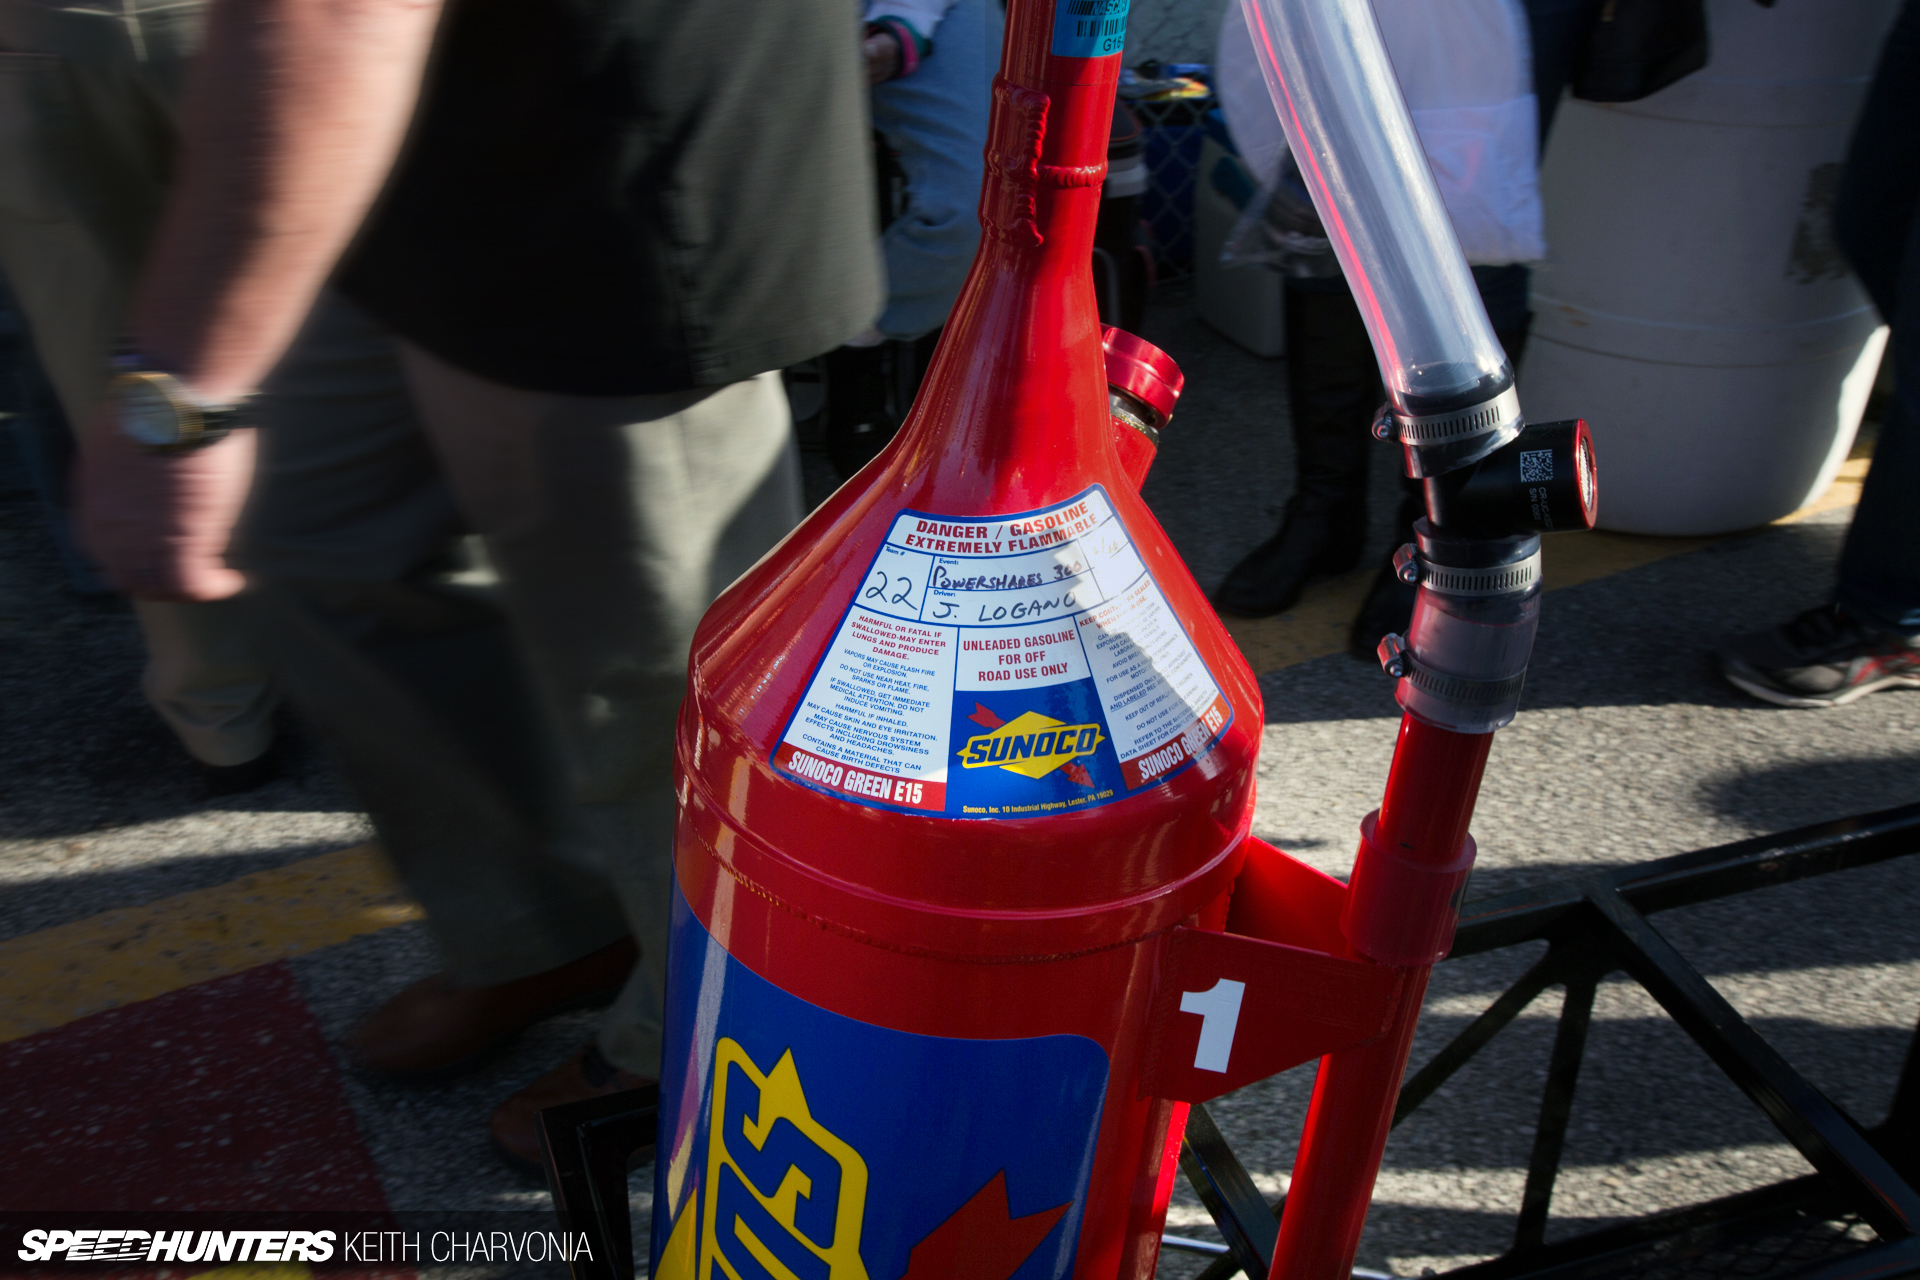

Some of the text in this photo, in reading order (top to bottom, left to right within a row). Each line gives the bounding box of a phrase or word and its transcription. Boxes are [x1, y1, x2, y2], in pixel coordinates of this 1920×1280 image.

[1529, 487, 1538, 502] S/N
[916, 501, 1089, 539] DANGER / GASOLINE
[905, 534, 1002, 553] EXTREMELY
[1008, 513, 1098, 552] FLAMMABLE
[885, 546, 899, 555] Team
[865, 571, 918, 611] 22
[933, 589, 956, 597] Driver:
[932, 591, 1076, 622] J. LOGANO
[1079, 615, 1097, 627] KEEP
[1134, 580, 1151, 596] SEALED
[859, 615, 892, 630] HARMFUL
[895, 625, 906, 633] OR
[908, 628, 931, 637] FATAL
[1096, 615, 1117, 629] WHEN
[851, 622, 946, 647] SWALLOWED-MAY ENTER
[852, 631, 939, 655] LUNGS AND PRODUCE
[963, 629, 1075, 651] UNLEADED GASOLINE
[1096, 633, 1122, 650] EXPOSURE
[872, 647, 909, 660] DAMAGE.
[1109, 643, 1120, 651] HAS
[844, 648, 865, 660] VAPORS
[879, 660, 899, 669] CAUSE
[900, 665, 920, 673] FLASH
[921, 669, 935, 677] FIRE
[998, 651, 1046, 666] FOR OFF
[1112, 657, 1128, 669] AVOID
[839, 663, 849, 671] DO
[862, 671, 875, 679] USE
[876, 675, 893, 683] NEAR
[872, 665, 907, 678] EXPLOSION.
[978, 662, 1068, 682] ROAD USE ONLY
[1106, 673, 1118, 684] FOR
[1118, 669, 1129, 678] USE
[830, 684, 856, 697] MEDICAL
[852, 675, 876, 686] SPARKS
[887, 685, 910, 694] FLAME.
[1113, 683, 1144, 701] DISPENSED
[1145, 676, 1157, 685] ONLY
[844, 696, 903, 716] INDUCE VOMITING.
[878, 692, 892, 700] GET
[893, 696, 930, 707] IMMEDIATE
[1110, 701, 1123, 711] AND
[1123, 690, 1147, 705] LABELED
[807, 702, 937, 741] MAY CAUSE SKIN AND EYE IRRITATION.
[835, 703, 866, 717] HARMFUL
[876, 715, 907, 727] INHALED.
[1125, 710, 1139, 721] KEEP
[1139, 704, 1149, 713] OUT
[1136, 721, 1146, 730] DO
[1146, 715, 1158, 725] NOT
[1158, 709, 1169, 719] USE
[1169, 702, 1179, 712] FOR
[805, 717, 929, 755] EFFECTS INCLUDING DROWSINESS
[814, 713, 921, 747] MAY CAUSE NERVOUS SYSTEM
[1120, 748, 1137, 759] DATA
[1138, 737, 1157, 751] SHEET
[1157, 730, 1169, 740] FOR
[1169, 713, 1195, 734] COMPLETE
[1134, 731, 1154, 745] REFER
[1154, 726, 1162, 734] TO
[1162, 719, 1173, 730] THE
[802, 734, 837, 750] CONTAINS
[844, 749, 880, 763] MATERIAL
[883, 758, 903, 767] THAT
[904, 763, 921, 771] CAN
[829, 734, 894, 755] AND HEADACHES.
[966, 727, 1098, 764] SUNOCO
[1138, 705, 1223, 780] SUNOCO GREEN E15
[816, 746, 900, 773] CAUSE BIRTH DEFECTS
[788, 751, 923, 804] SUNOCO GREEN E15
[963, 805, 988, 814] Sunoco,
[1011, 803, 1040, 813] Industrial
[1041, 800, 1067, 811] Highway,
[1088, 794, 1096, 802] PA
[1180, 978, 1245, 1073] 1
